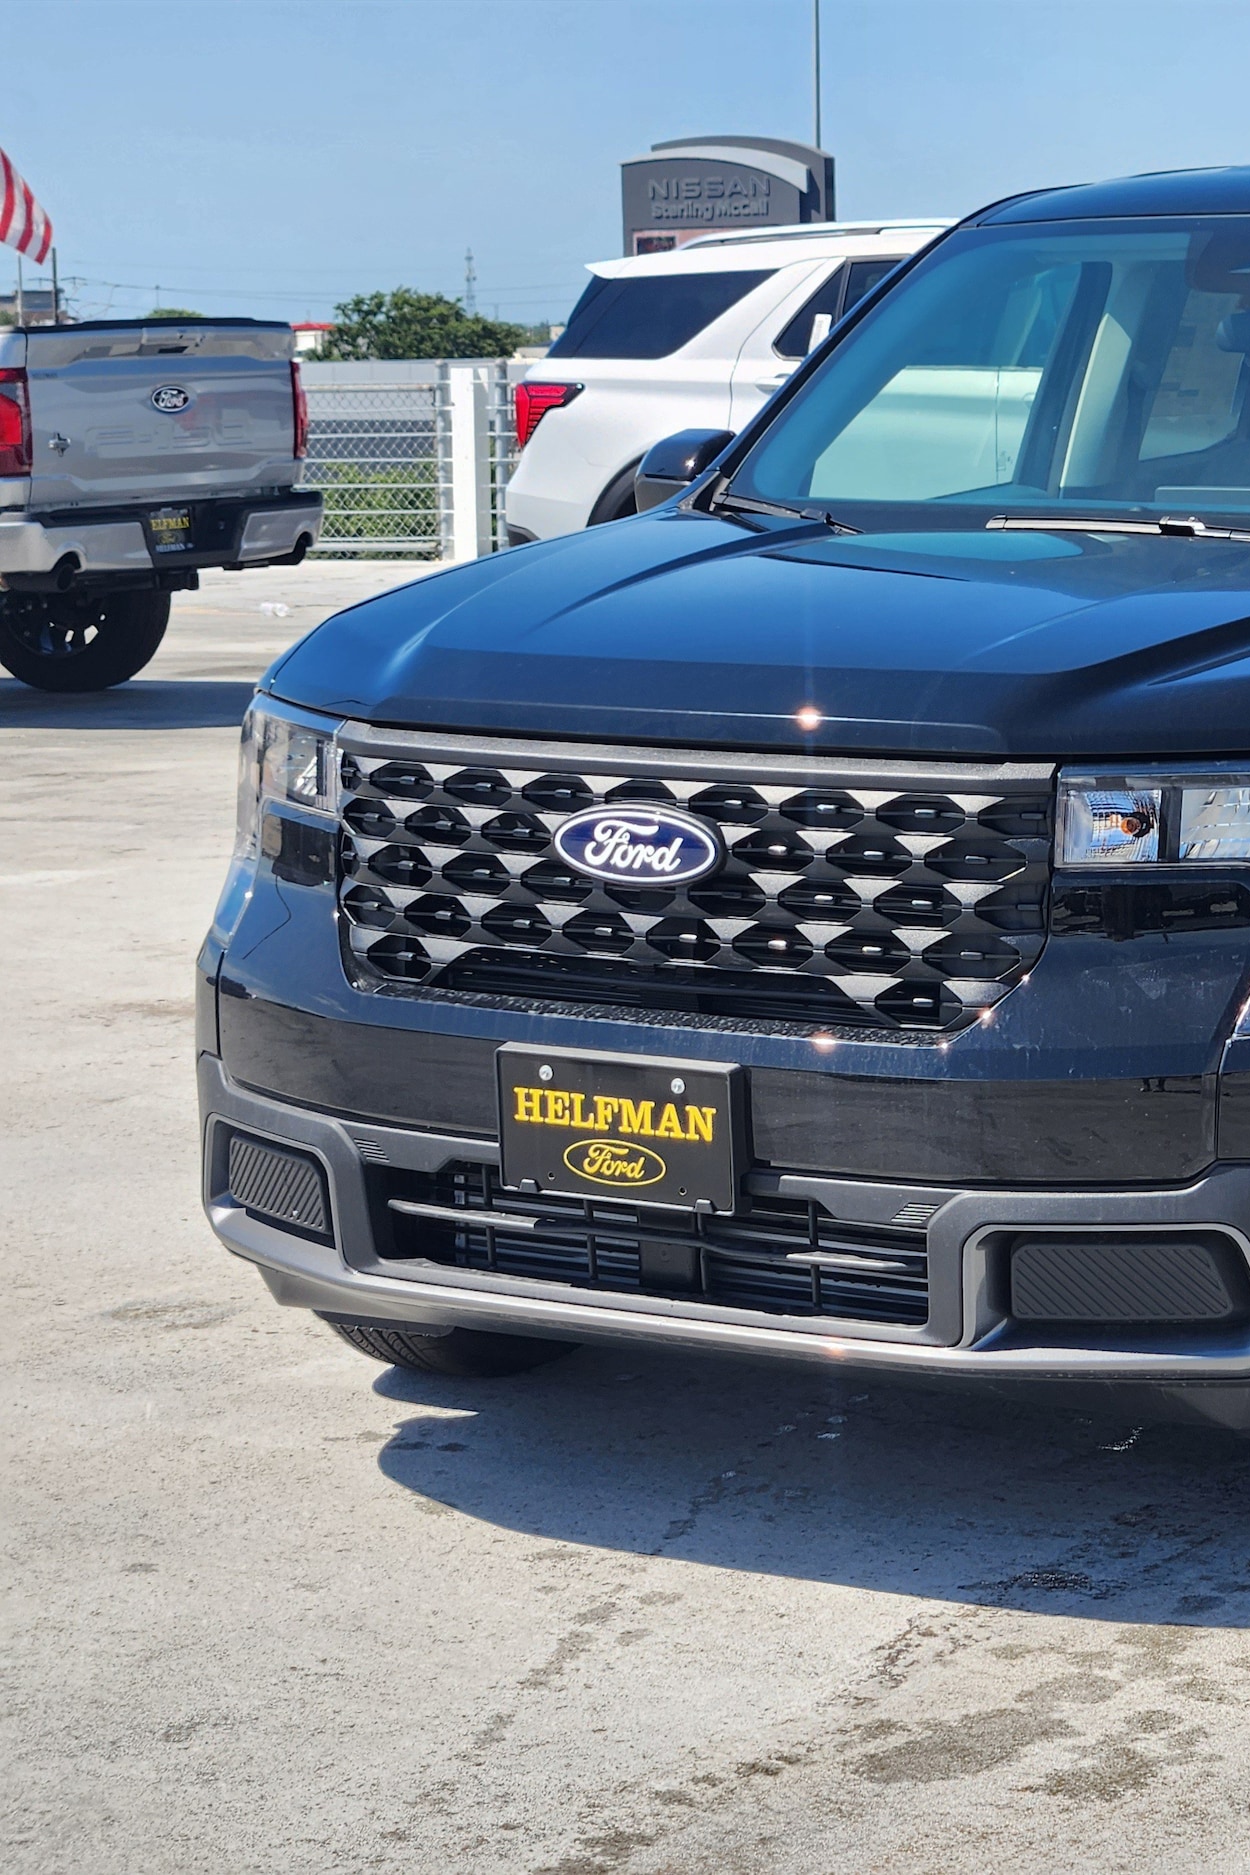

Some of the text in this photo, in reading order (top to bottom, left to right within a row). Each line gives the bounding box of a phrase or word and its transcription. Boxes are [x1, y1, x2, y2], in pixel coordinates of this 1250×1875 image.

[648, 176, 770, 200] NISSAN
[158, 390, 184, 407] Ford
[584, 820, 683, 872] Ford
[513, 1086, 717, 1142] HELFMAN
[583, 1144, 645, 1179] Ford
